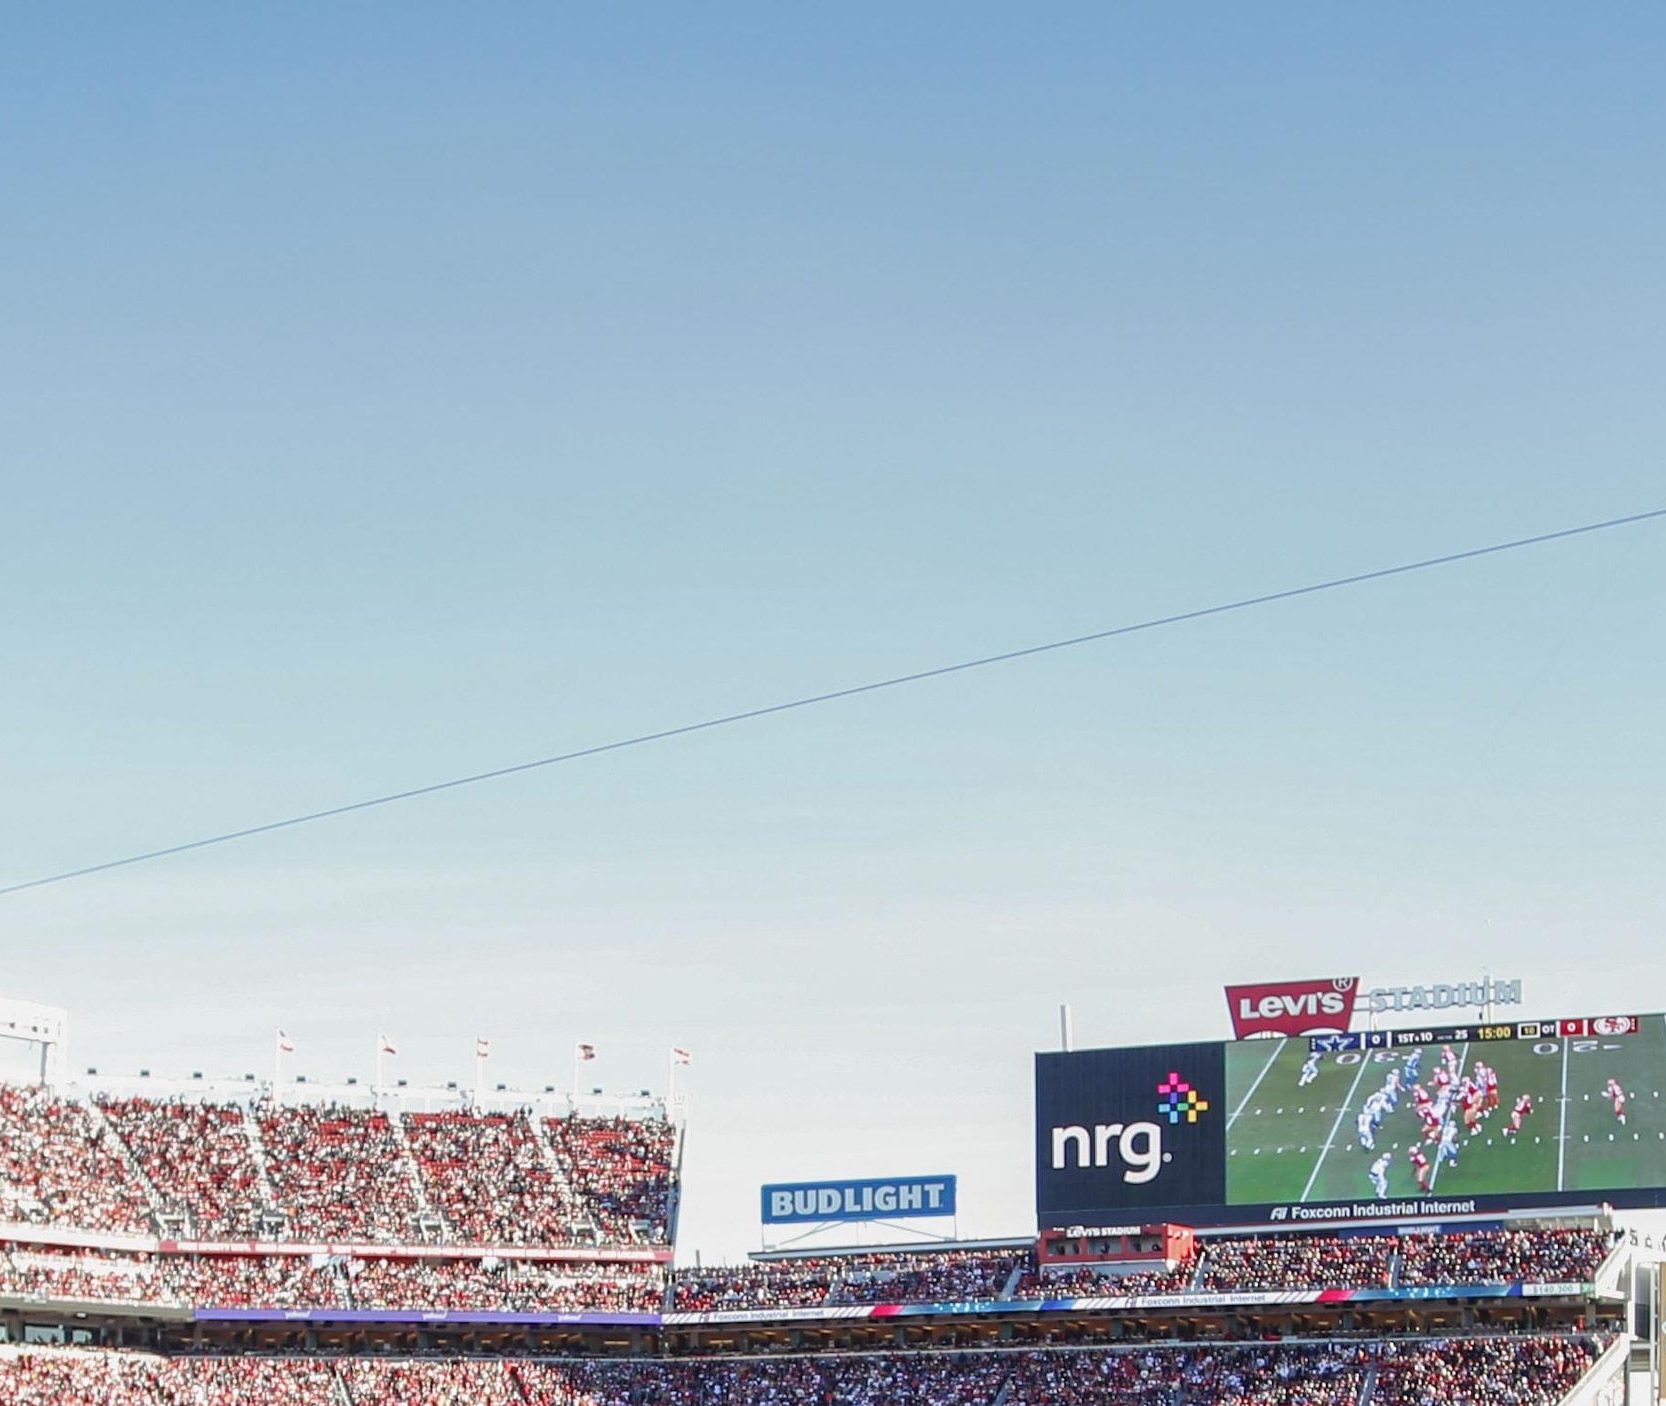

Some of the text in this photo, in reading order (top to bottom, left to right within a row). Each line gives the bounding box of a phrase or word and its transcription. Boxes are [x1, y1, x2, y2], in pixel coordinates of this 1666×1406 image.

[1368, 979, 1522, 1012] STADIUM
[1477, 1027, 1511, 1039] 15:00
[1052, 1121, 1163, 1184] nrg
[771, 1183, 945, 1217] BUD LIGHT
[1291, 1200, 1475, 1220] Foxconn Industrial Internet
